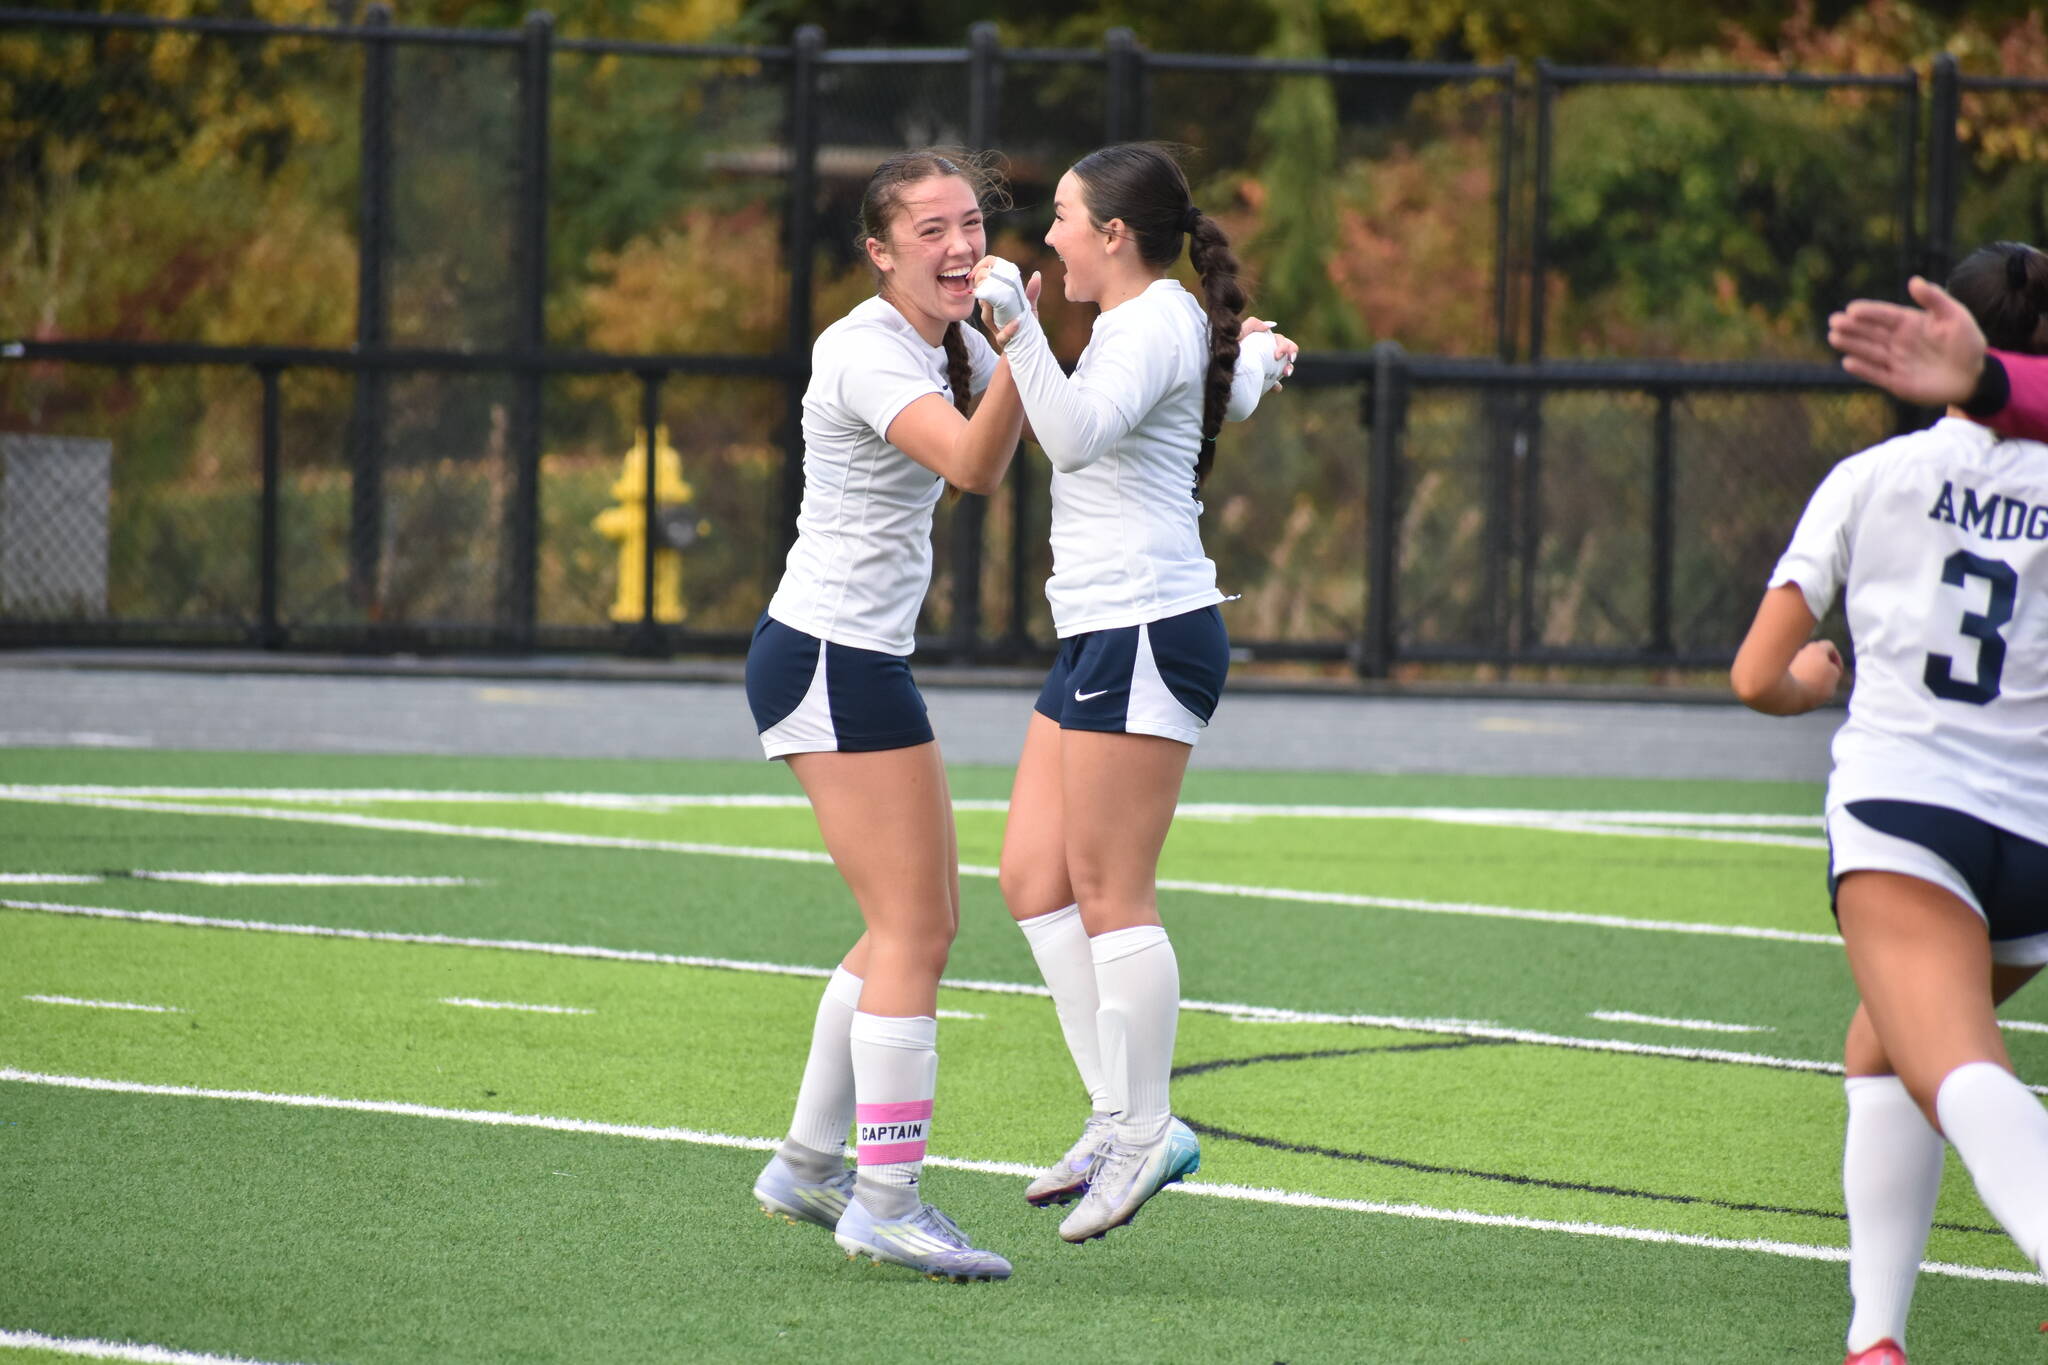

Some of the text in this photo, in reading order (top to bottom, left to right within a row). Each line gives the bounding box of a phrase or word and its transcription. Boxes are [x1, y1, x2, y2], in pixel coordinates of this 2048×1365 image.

[1928, 480, 2048, 540] AMDG
[1923, 549, 2018, 706] 3
[862, 1123, 922, 1141] CAPTAIN
